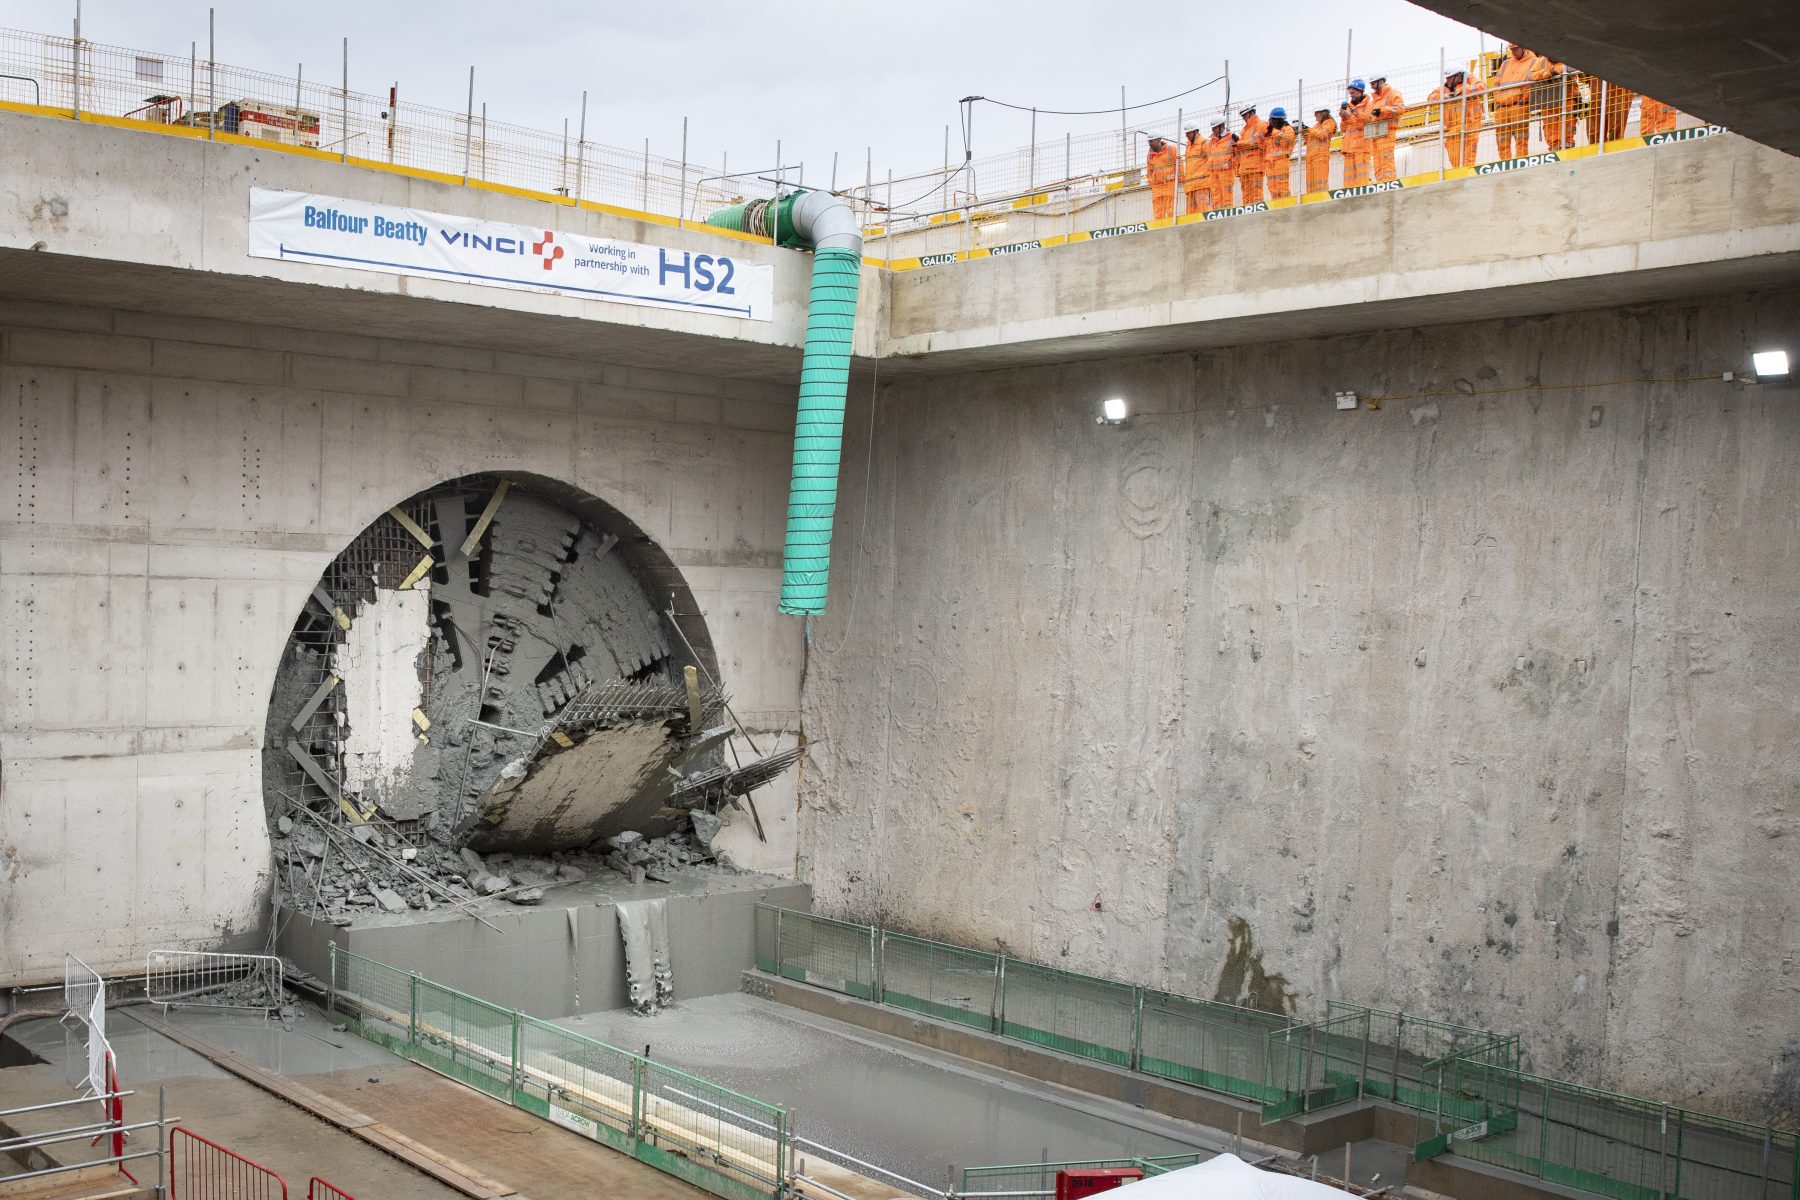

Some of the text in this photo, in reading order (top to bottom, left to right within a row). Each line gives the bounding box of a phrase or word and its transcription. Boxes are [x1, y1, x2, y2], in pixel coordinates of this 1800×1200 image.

[1478, 153, 1557, 175] GALLDRIS
[1333, 180, 1400, 200] GALLDRIS
[1206, 202, 1266, 221] GALLDRIS
[304, 205, 428, 246] Balfour Beatty
[1093, 223, 1147, 239] GALLDRIS
[440, 229, 525, 256] VINCI
[588, 243, 636, 260] Working in
[992, 241, 1040, 256] GALLDRIS
[574, 256, 650, 276] partnership with
[659, 248, 735, 295] HS2
